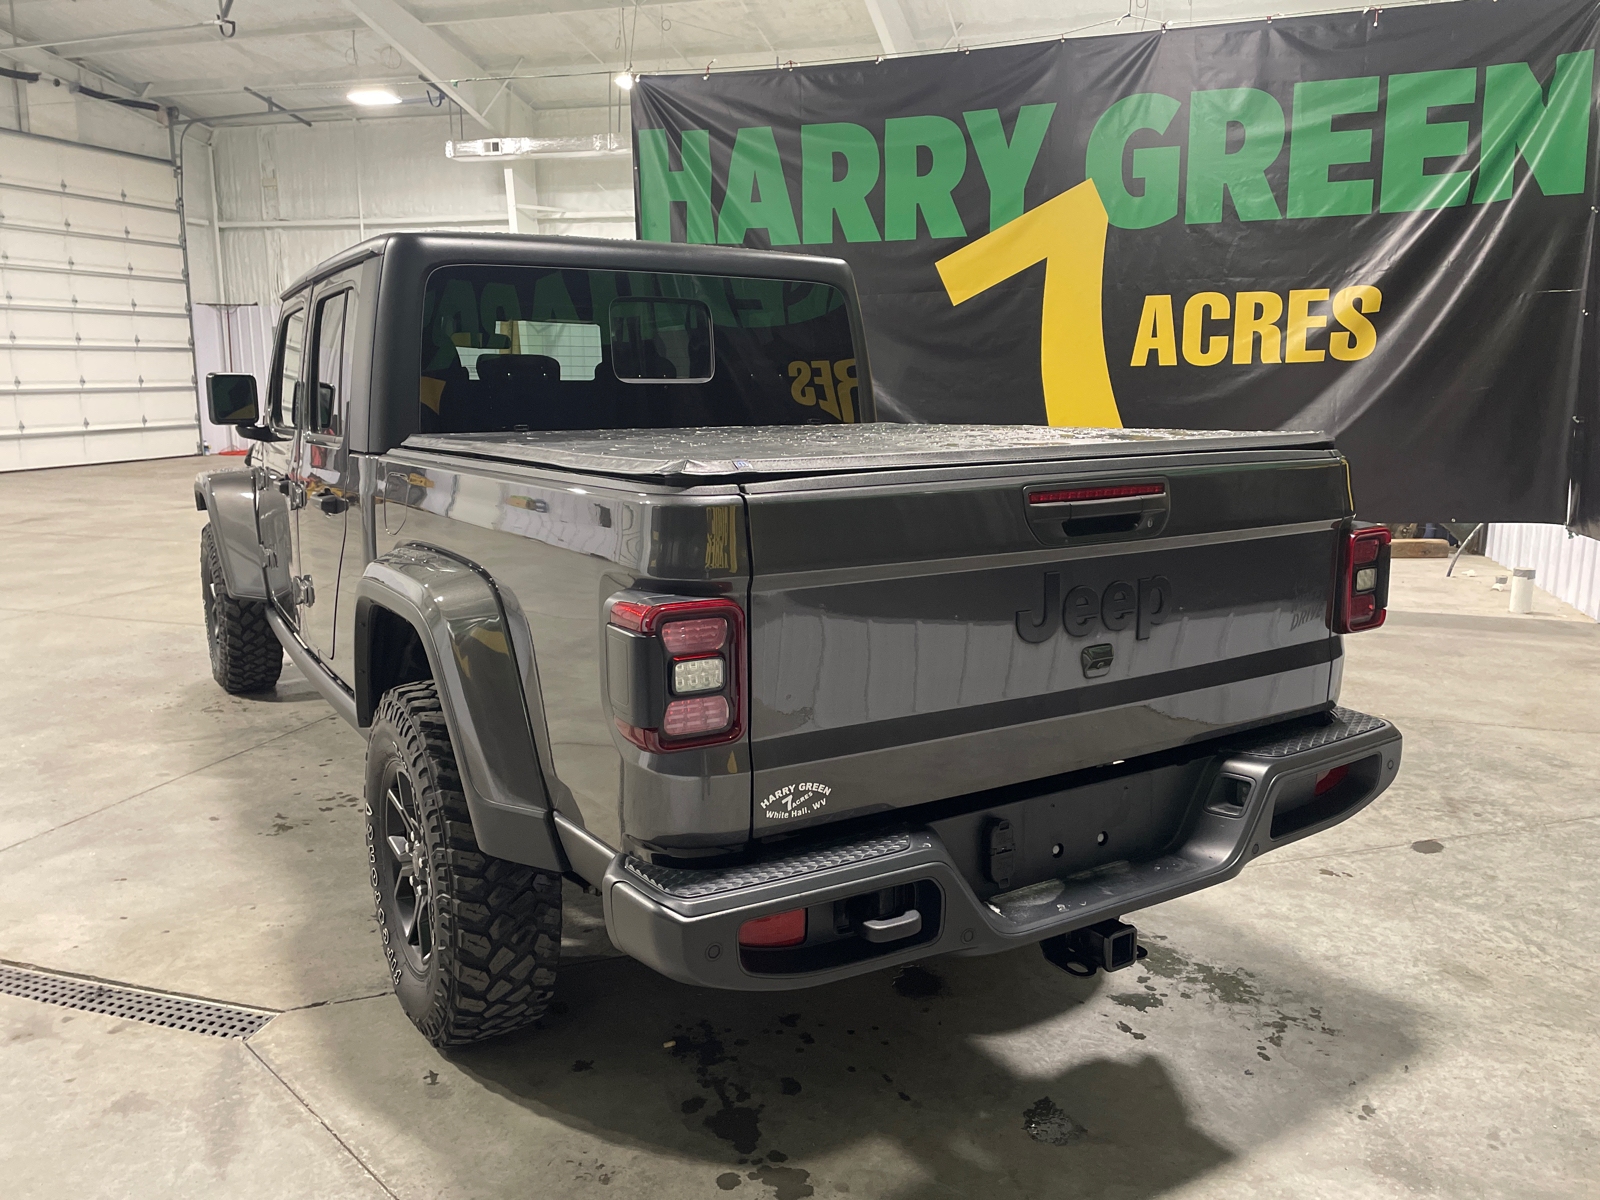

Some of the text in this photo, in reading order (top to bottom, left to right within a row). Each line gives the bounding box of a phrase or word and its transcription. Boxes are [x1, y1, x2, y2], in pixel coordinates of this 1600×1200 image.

[638, 48, 1595, 245] HARRY GREEN
[936, 178, 1383, 429] 7 ACRES
[1015, 571, 1172, 644] Jeep
[1290, 604, 1324, 631] DRIVE
[760, 782, 832, 809] HARRY GREEN
[766, 797, 827, 819] White Hall, WV
[781, 791, 813, 811] 7 ACRES
